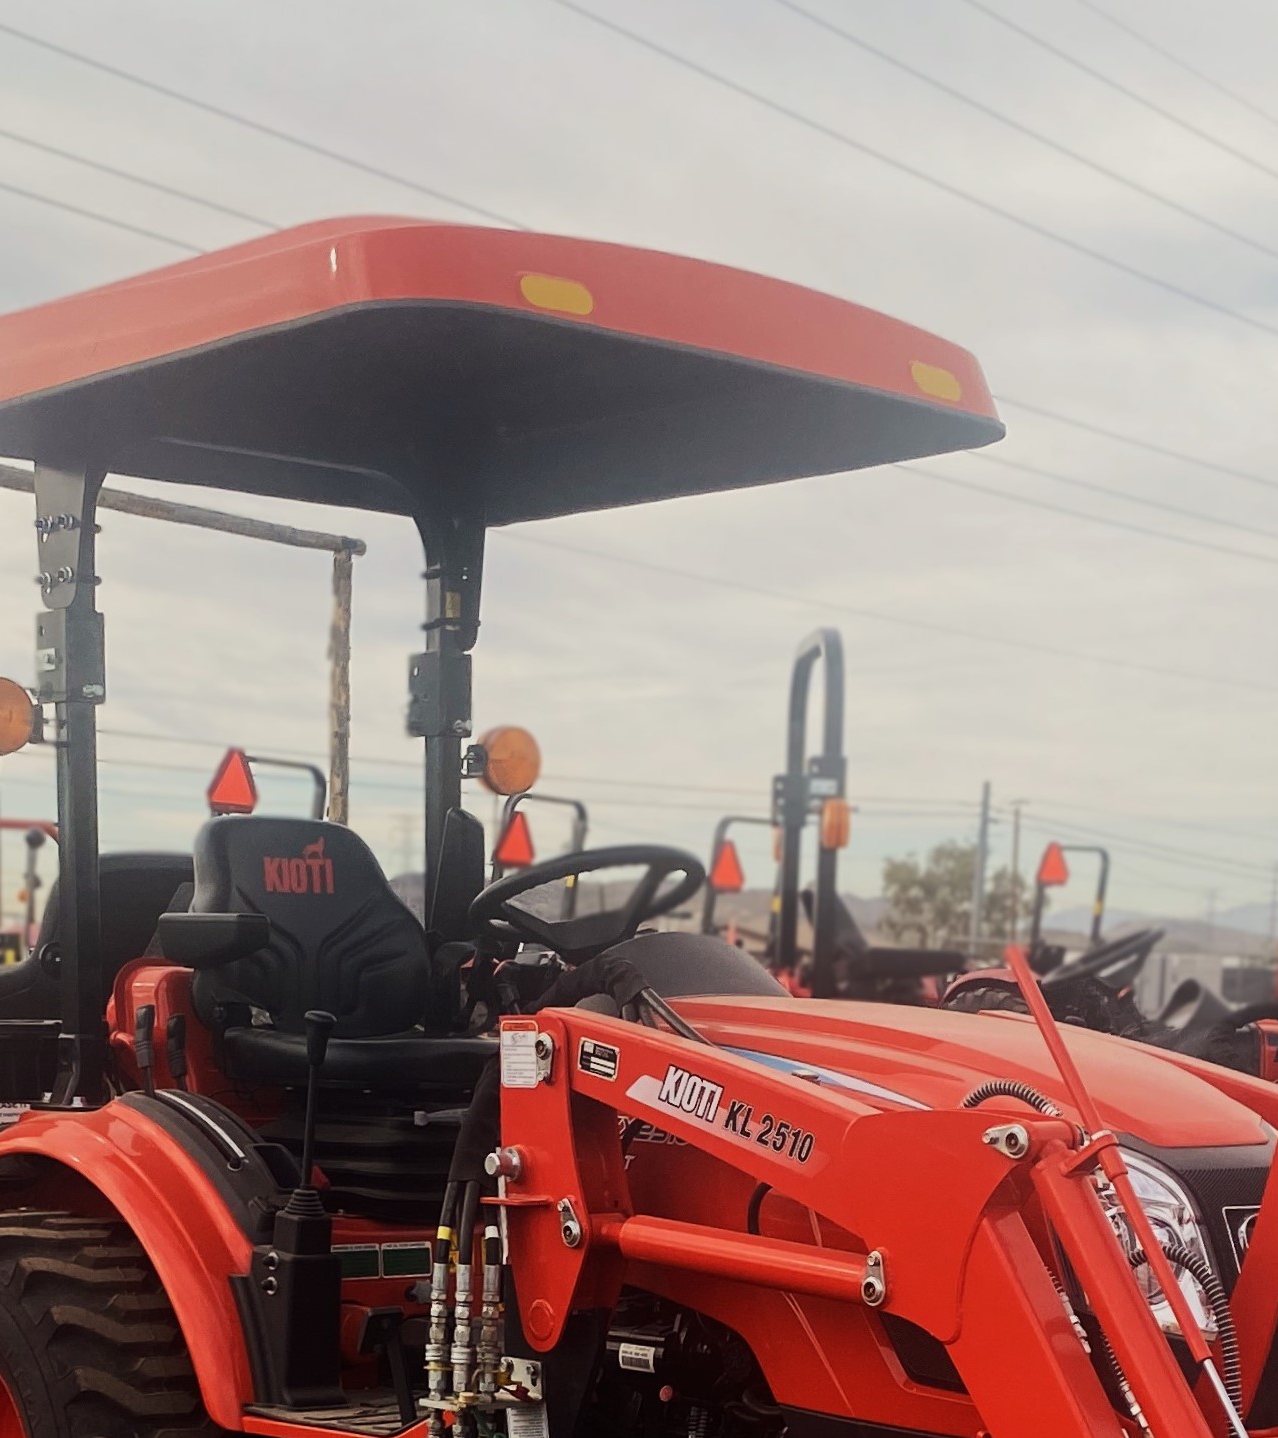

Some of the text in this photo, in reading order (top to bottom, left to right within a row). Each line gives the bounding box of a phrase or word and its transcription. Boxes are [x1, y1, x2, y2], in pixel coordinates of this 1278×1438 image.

[263, 855, 335, 894] KIOTI
[658, 1064, 816, 1165] KIOTI KL 2510
